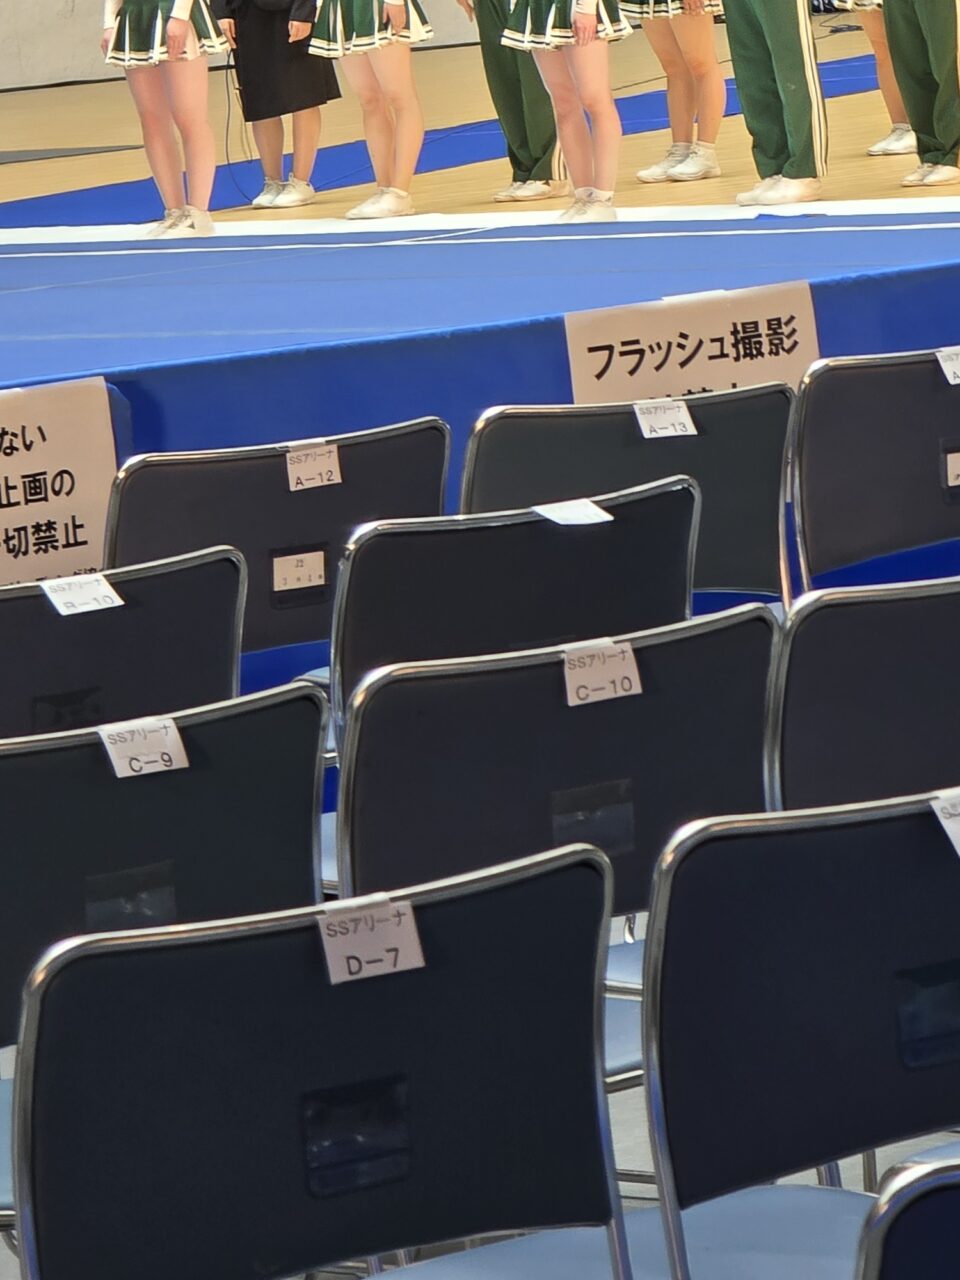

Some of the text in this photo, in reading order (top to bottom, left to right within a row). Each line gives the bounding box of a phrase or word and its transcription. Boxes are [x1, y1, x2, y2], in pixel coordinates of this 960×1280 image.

[587, 315, 800, 381] フラッシュ撮影
[0, 424, 47, 457] ない
[649, 422, 688, 435] A-13
[295, 470, 335, 488] A-12
[0, 515, 88, 559] 切禁止
[567, 648, 629, 671] SSアリーナ
[576, 675, 634, 702] C-10
[128, 752, 174, 773] C-9
[325, 910, 407, 938] SSアリーナ
[345, 947, 400, 976] D-7
